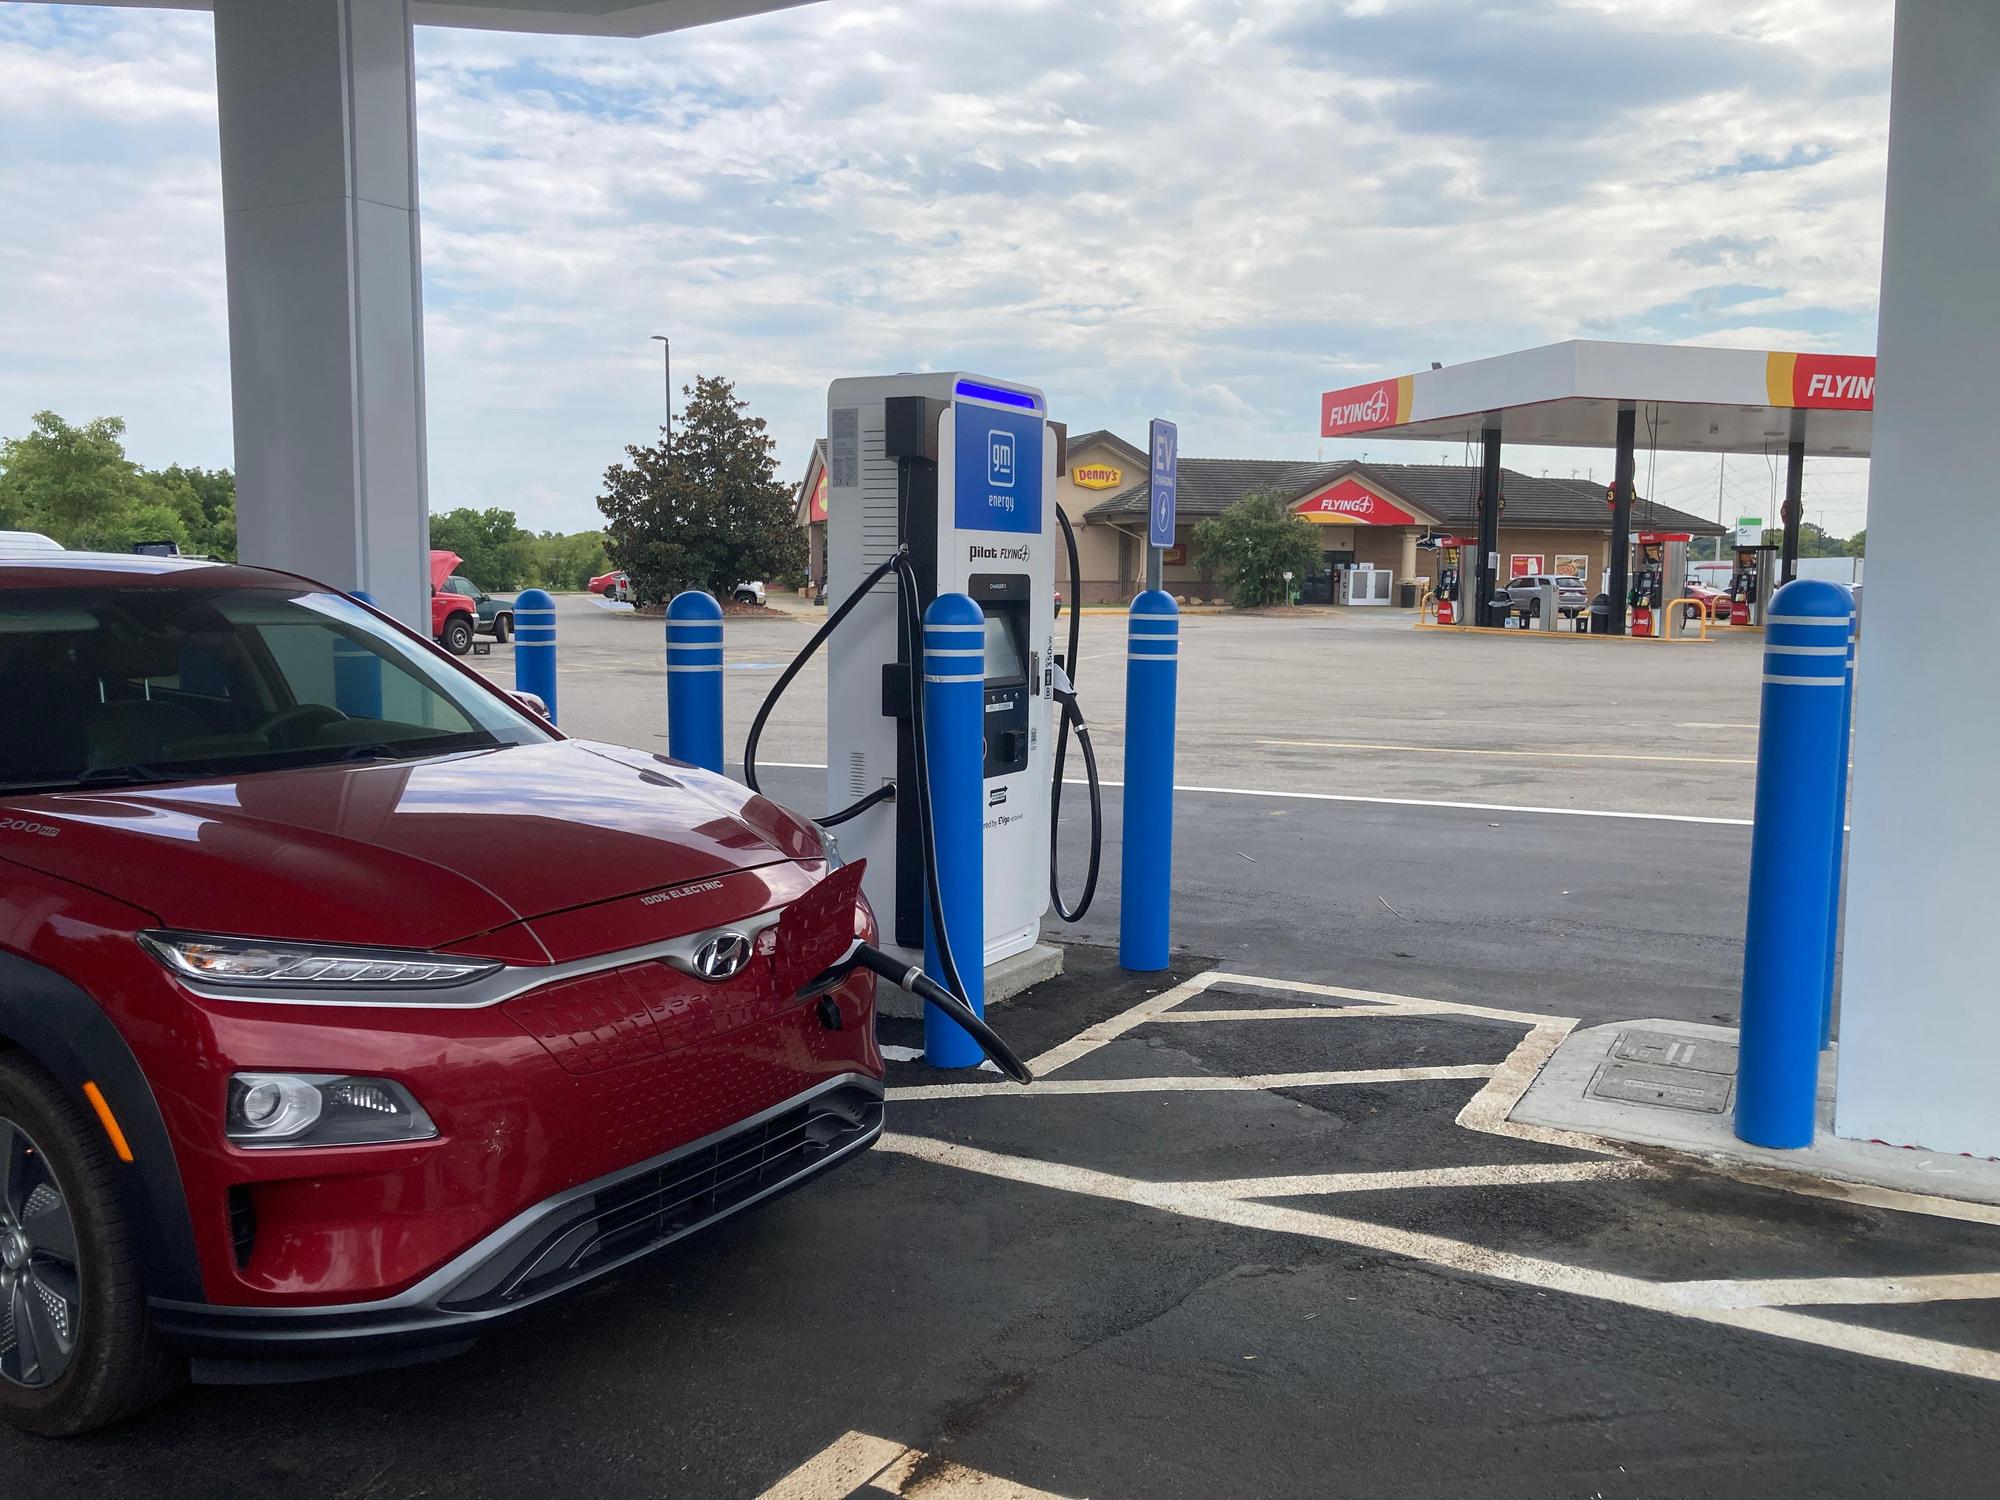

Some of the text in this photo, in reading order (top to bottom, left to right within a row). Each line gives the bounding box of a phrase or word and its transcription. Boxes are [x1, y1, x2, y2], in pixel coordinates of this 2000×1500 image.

[1807, 373, 1875, 399] FLYIN
[992, 444, 1011, 473] gm
[1156, 435, 1174, 472] EV
[1078, 468, 1118, 483] Denny's
[988, 494, 1015, 512] energy
[1499, 500, 1505, 508] 2
[1607, 491, 1614, 500] 3
[969, 545, 998, 562] pilot
[0, 817, 41, 832] 200
[640, 880, 724, 906] 100% ELECTRIC
